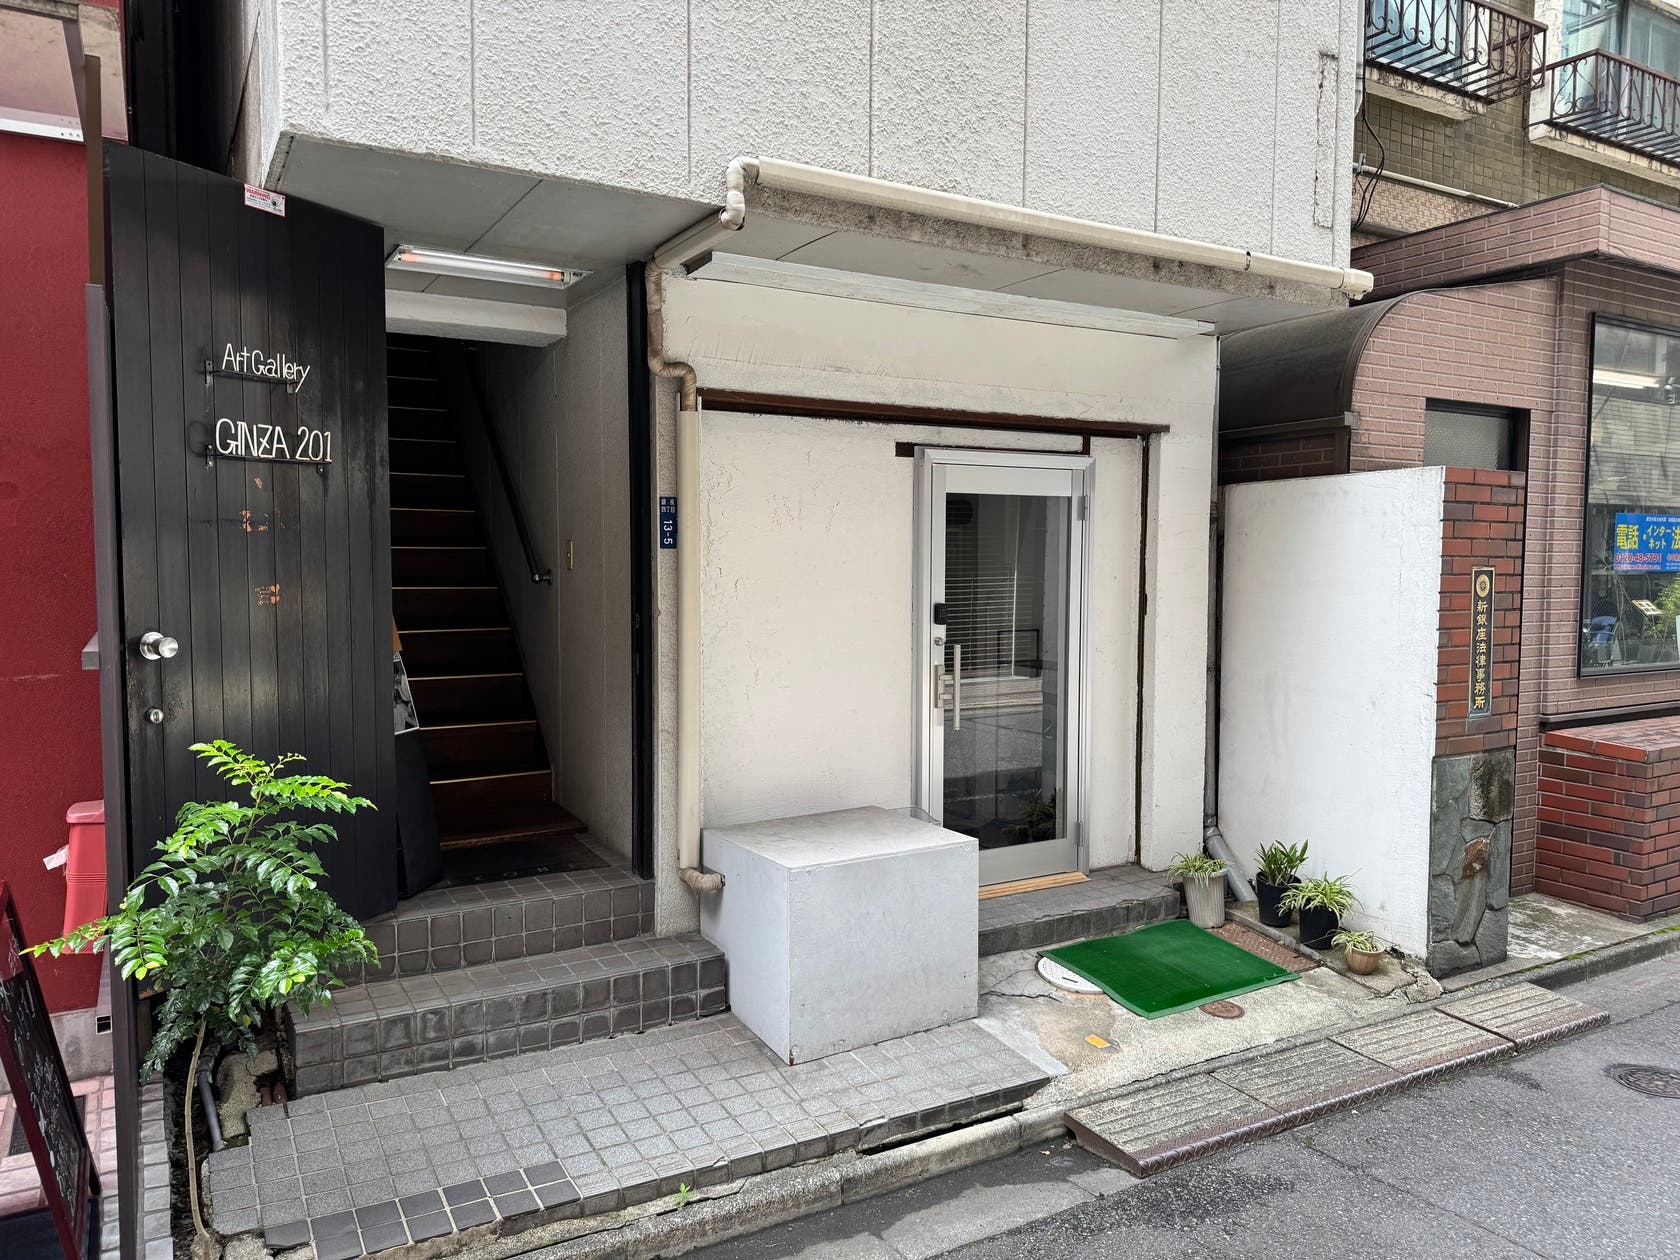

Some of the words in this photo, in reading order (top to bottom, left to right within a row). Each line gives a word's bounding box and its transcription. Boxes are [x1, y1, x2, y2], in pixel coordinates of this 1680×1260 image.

[246, 188, 271, 200] WARNING
[222, 343, 251, 373] Art
[251, 350, 311, 394] Gallery
[215, 417, 291, 459] GINZA
[295, 425, 334, 463] 201
[664, 520, 673, 545] 13-5
[1473, 600, 1489, 710] 新銀座法律事務所
